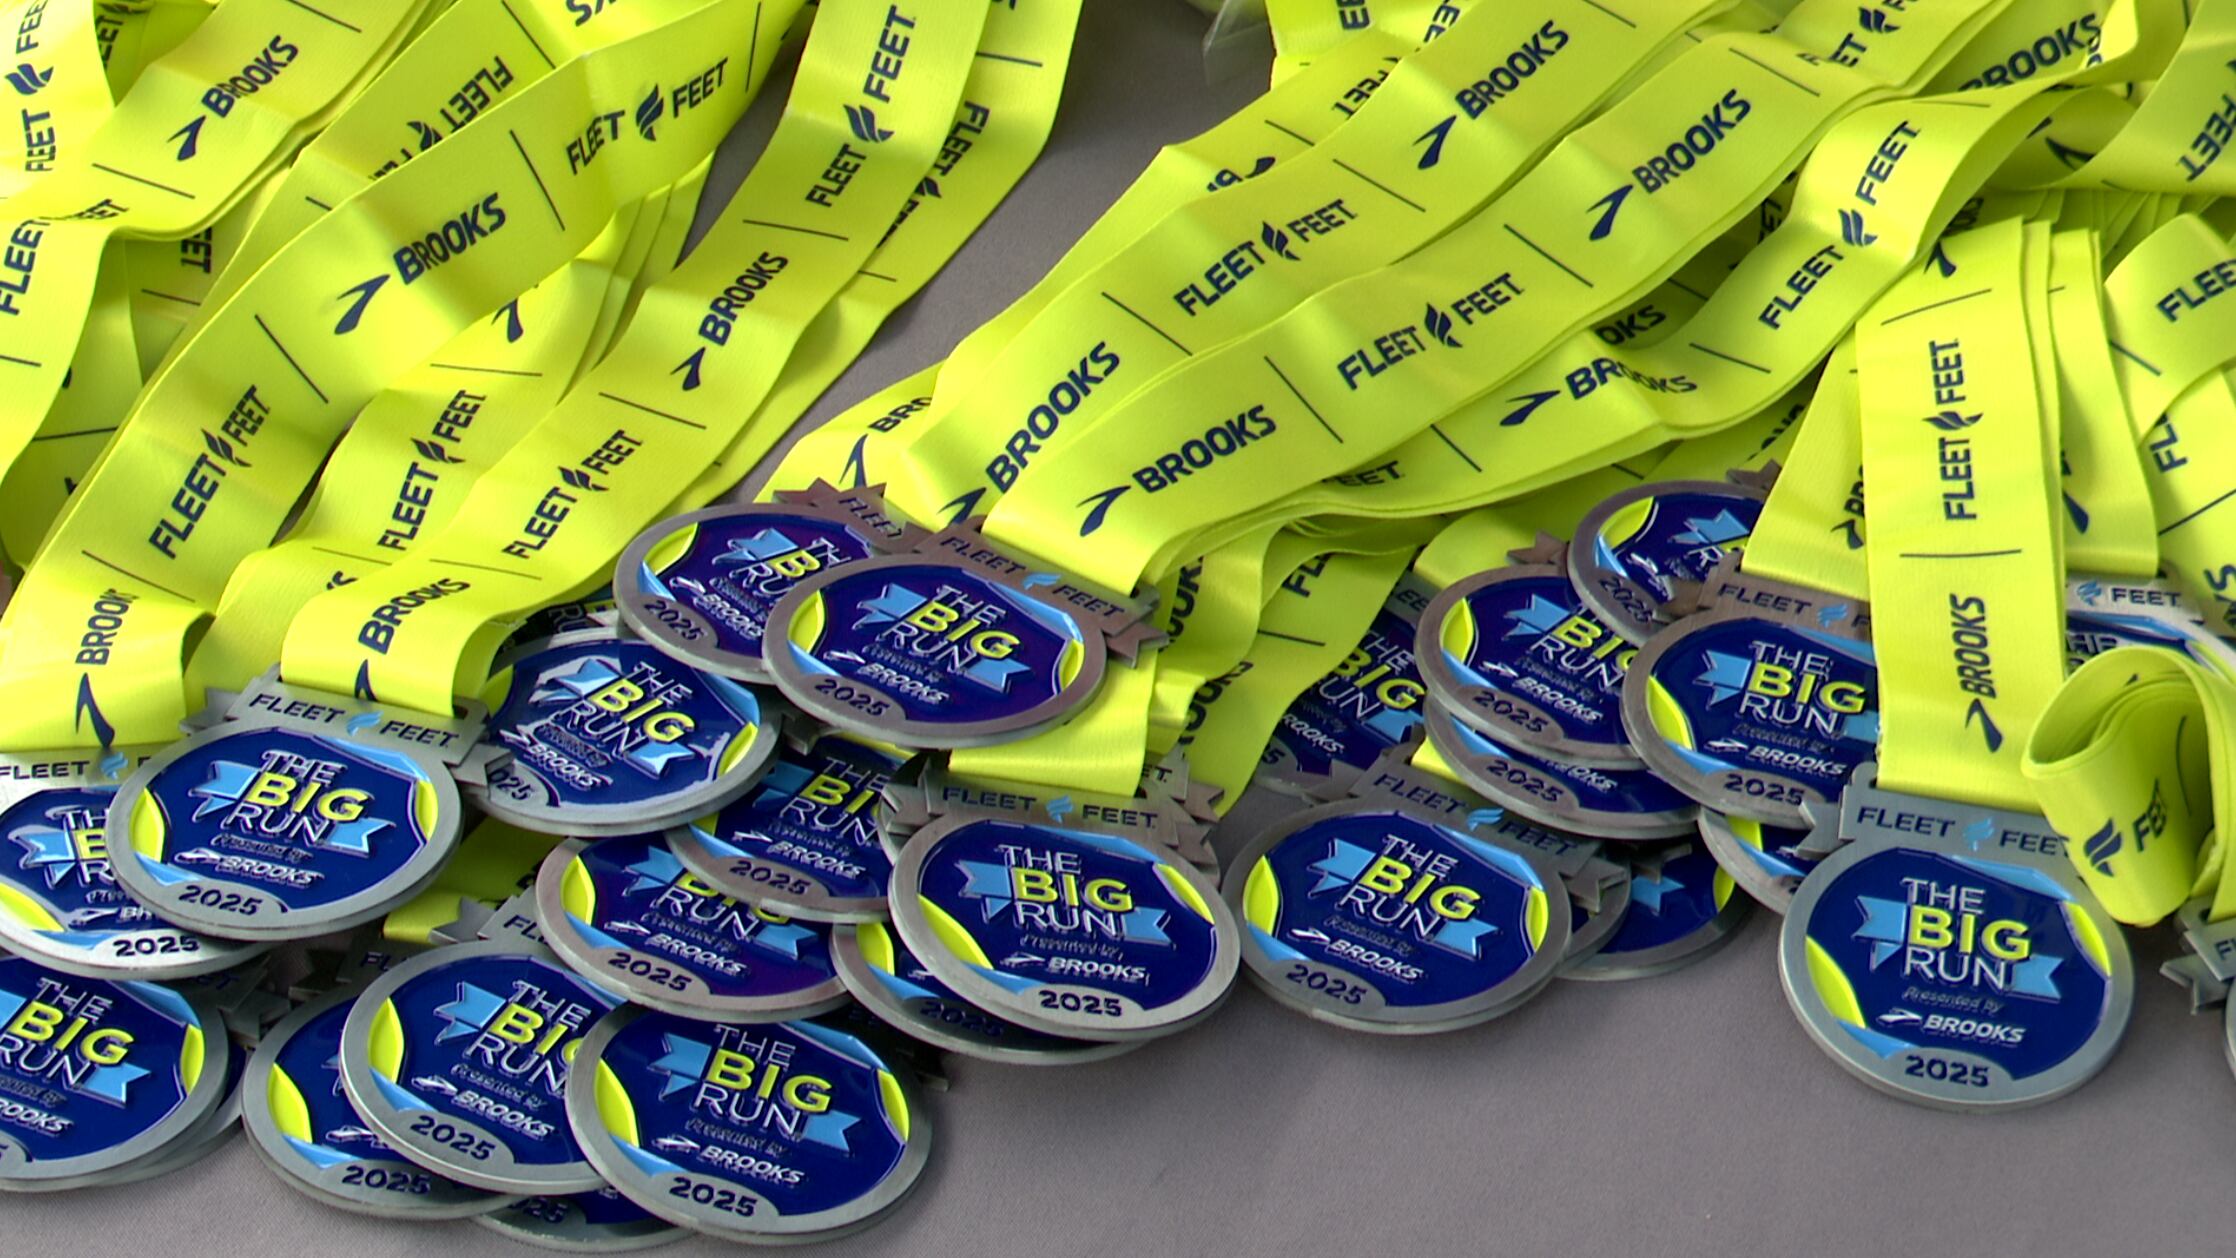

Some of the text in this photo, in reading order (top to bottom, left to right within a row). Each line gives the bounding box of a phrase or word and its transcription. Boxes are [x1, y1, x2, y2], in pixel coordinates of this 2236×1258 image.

[16, 0, 56, 172] FLEET FEE
[202, 35, 299, 117] BROOKS
[1455, 20, 1570, 120] BROOKS
[440, 55, 514, 133] FLEET
[566, 57, 729, 175] FLEET FEET
[806, 4, 916, 207] FLEET FEET
[940, 101, 991, 177] FLEET
[1632, 89, 1751, 193] BROOKS
[393, 192, 506, 285] BROOKS
[1758, 244, 1845, 330] FLEET
[1856, 120, 1921, 206] FEET
[1174, 199, 1358, 316] FLEET FEET
[699, 252, 789, 347] BROOKS
[2156, 259, 2236, 322] FLEE
[1337, 272, 1524, 391] FLEET FEET
[868, 396, 933, 433] BRO
[985, 341, 1120, 494] BROOKS
[1929, 338, 1977, 521] FLEET FEET
[377, 389, 487, 551] FLEET FEET
[1132, 404, 1277, 494] BROOKS
[149, 384, 270, 560] FLEET FEET
[502, 429, 643, 559] FLEET FEET
[812, 537, 851, 569] TH
[941, 536, 1124, 620] FLEET FEET
[1717, 583, 1812, 615] FLEET
[2111, 587, 2182, 606] FEET
[358, 577, 471, 655] BROOKS
[644, 600, 707, 641] 2025
[935, 585, 1006, 627] THE
[884, 622, 977, 674] RUN
[907, 602, 1021, 660] BIG
[1949, 593, 1997, 699] BROOKS
[1530, 635, 1625, 688] RUN
[1749, 641, 1832, 676] THE
[633, 661, 693, 707] THE
[814, 679, 890, 718] 2025
[859, 664, 949, 704] BROOKS
[1318, 676, 1381, 720] UN
[1512, 677, 1603, 725] BROOKS
[1748, 662, 1866, 714] BIG
[249, 693, 459, 748] FLEET FEET
[561, 700, 652, 754] RUN
[588, 679, 695, 743] BIG
[1284, 712, 1345, 752] ROOKS
[1473, 691, 1548, 733] 2025
[1739, 692, 1841, 735] RUN
[262, 750, 348, 786] THE
[826, 757, 891, 793] THE
[1486, 759, 1564, 804] 2025
[1750, 745, 1847, 776] BROOKS
[247, 771, 370, 821] BIG
[490, 768, 534, 801] 025
[801, 774, 880, 818] BI
[1723, 773, 1805, 805] 2025
[60, 808, 109, 830] TH
[226, 803, 331, 843] RUN
[780, 797, 878, 846] RUN
[943, 787, 1159, 830] FLEET FEET
[1373, 773, 1581, 857] FLEET FEET
[1857, 806, 1956, 837] FLEET
[219, 856, 321, 887] BROOKS
[730, 860, 811, 896] 2025
[770, 841, 866, 880] BROOKS
[1000, 844, 1081, 874] THE
[1382, 834, 1459, 878] THE
[178, 884, 263, 916] 2025
[1011, 867, 1133, 912] BIG
[1359, 855, 1481, 920] BIG
[1901, 877, 1987, 915] THE
[657, 886, 761, 940] RUN
[1015, 901, 1117, 937] RUN
[1339, 885, 1441, 938] RUN
[1908, 904, 2031, 961] BIG
[113, 936, 200, 958] 2025
[645, 932, 749, 976] BROOKS
[1048, 956, 1147, 980] BROOKS
[1329, 938, 1424, 981] BROOKS
[1906, 947, 2006, 990] RUN
[608, 952, 693, 992] 2025
[1286, 963, 1368, 1006] 2025
[37, 977, 113, 1024] THE
[512, 980, 592, 1031] THE
[1039, 989, 1123, 1017] 2025
[9, 1001, 135, 1065] BIG
[714, 1023, 796, 1067] THE
[1923, 1014, 2026, 1044] BROOKS
[467, 1032, 567, 1093] RUN
[705, 1048, 832, 1112] BIG
[1905, 1054, 1990, 1087] 2025
[455, 1090, 555, 1138] BROOKS
[695, 1082, 800, 1135] RUN
[410, 1114, 496, 1161] 2025
[342, 1165, 431, 1195] 2025
[699, 1144, 805, 1184] BROOKS
[669, 1176, 757, 1218] 2025
